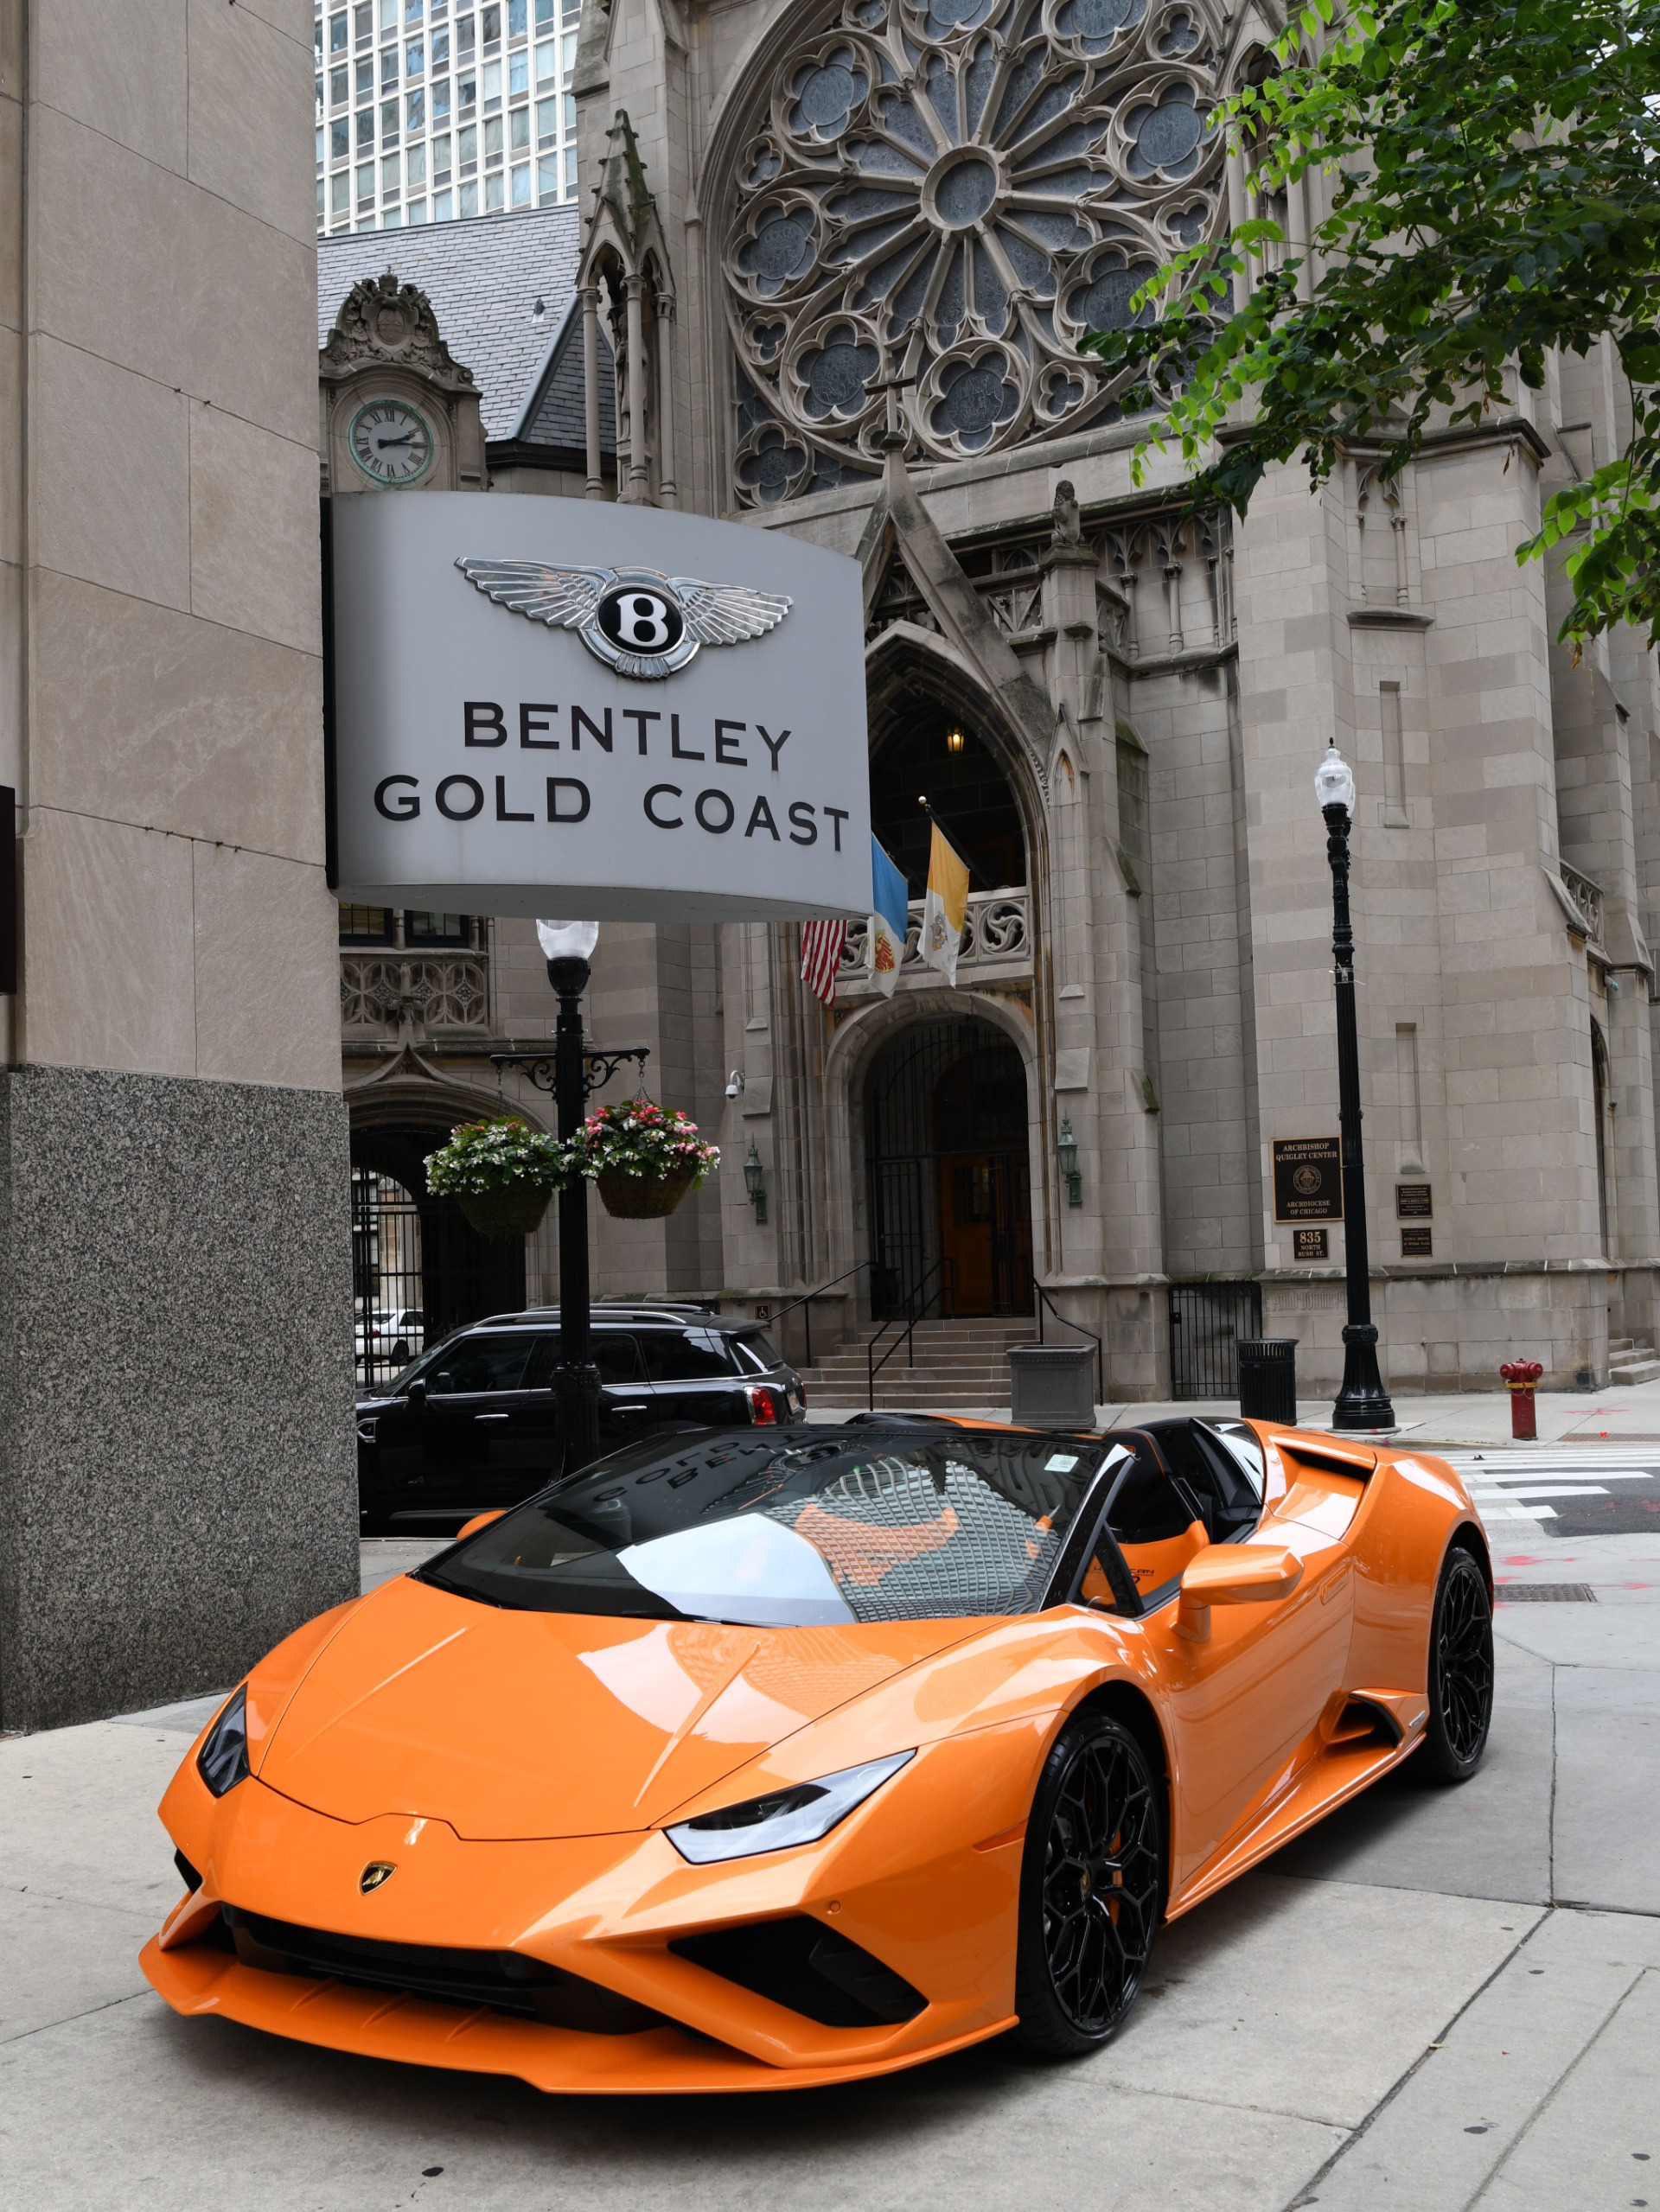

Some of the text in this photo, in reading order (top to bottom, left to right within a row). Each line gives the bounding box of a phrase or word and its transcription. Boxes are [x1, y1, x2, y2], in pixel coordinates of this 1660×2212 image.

[463, 701, 792, 771] BENTLEY
[374, 774, 850, 852] GOLD COAST
[1283, 1143, 1330, 1152] ARCHBISHOP
[1275, 1151, 1338, 1162] QUIGLEY CENTER
[1299, 1231, 1321, 1244] 835
[1094, 1566, 1155, 1575] HCAN
